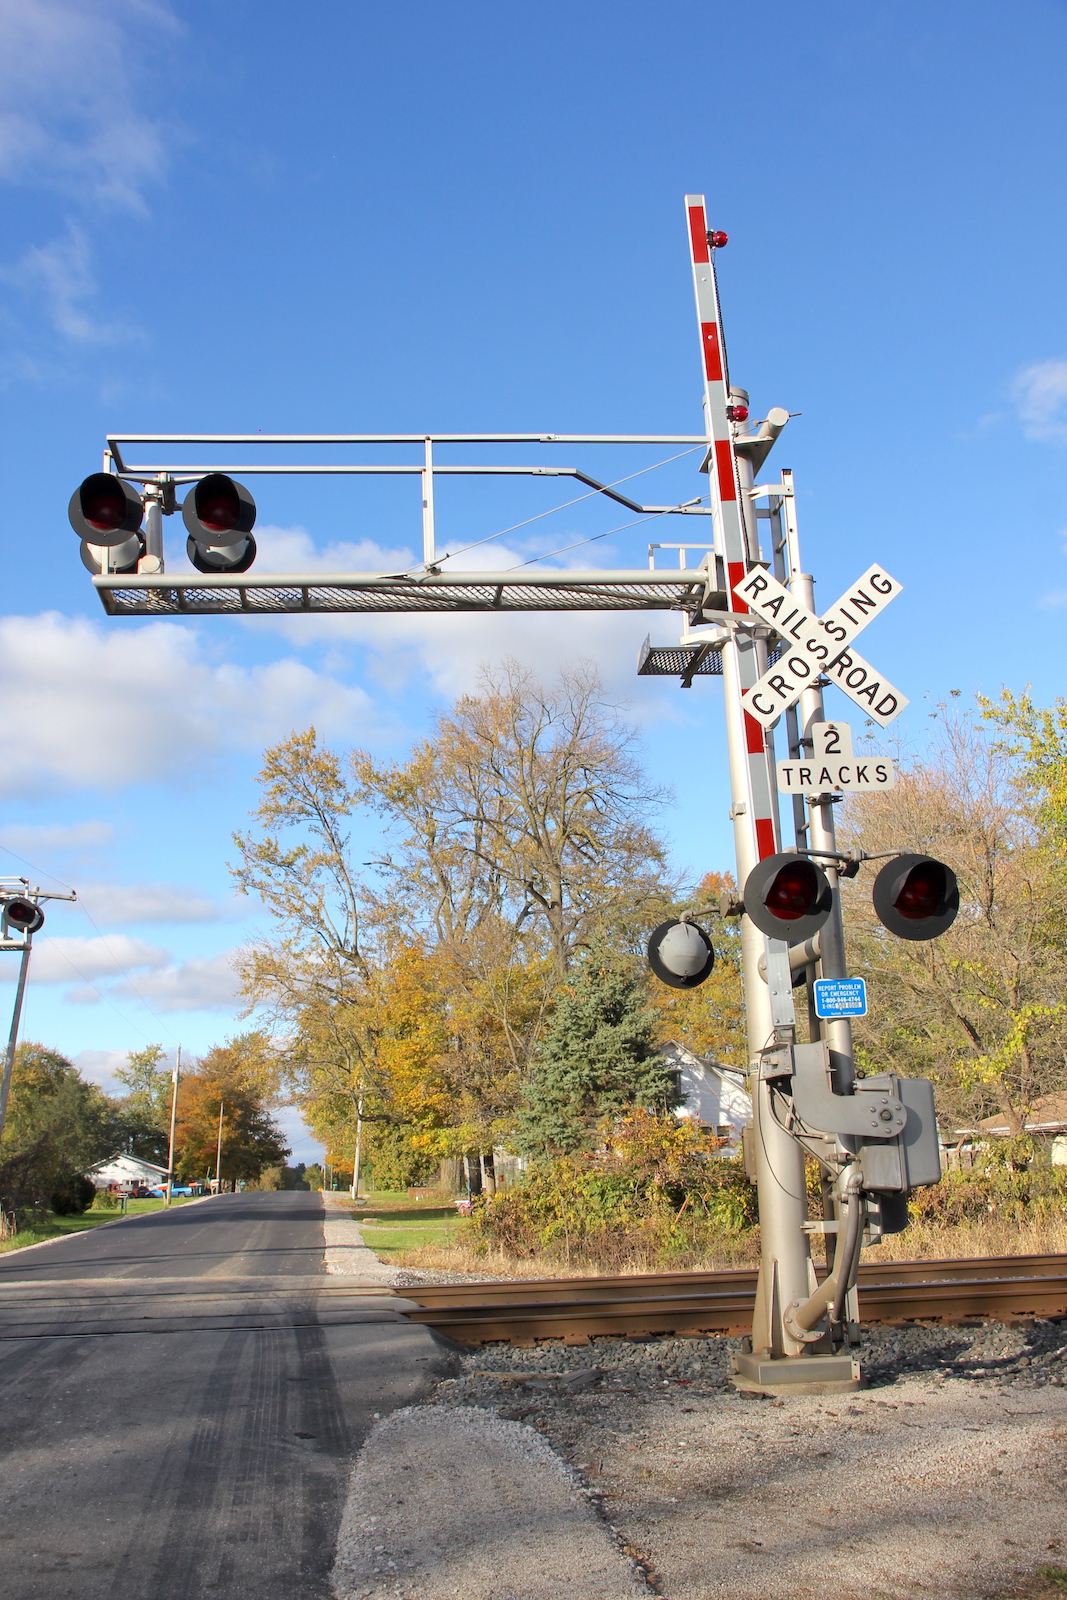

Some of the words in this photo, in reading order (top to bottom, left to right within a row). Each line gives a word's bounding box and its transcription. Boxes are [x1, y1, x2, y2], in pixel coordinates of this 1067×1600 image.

[743, 574, 808, 640] RAIL
[832, 650, 898, 717] ROAD
[751, 573, 893, 715] CROSSING
[782, 765, 888, 786] TRACKS
[823, 730, 842, 754] 2
